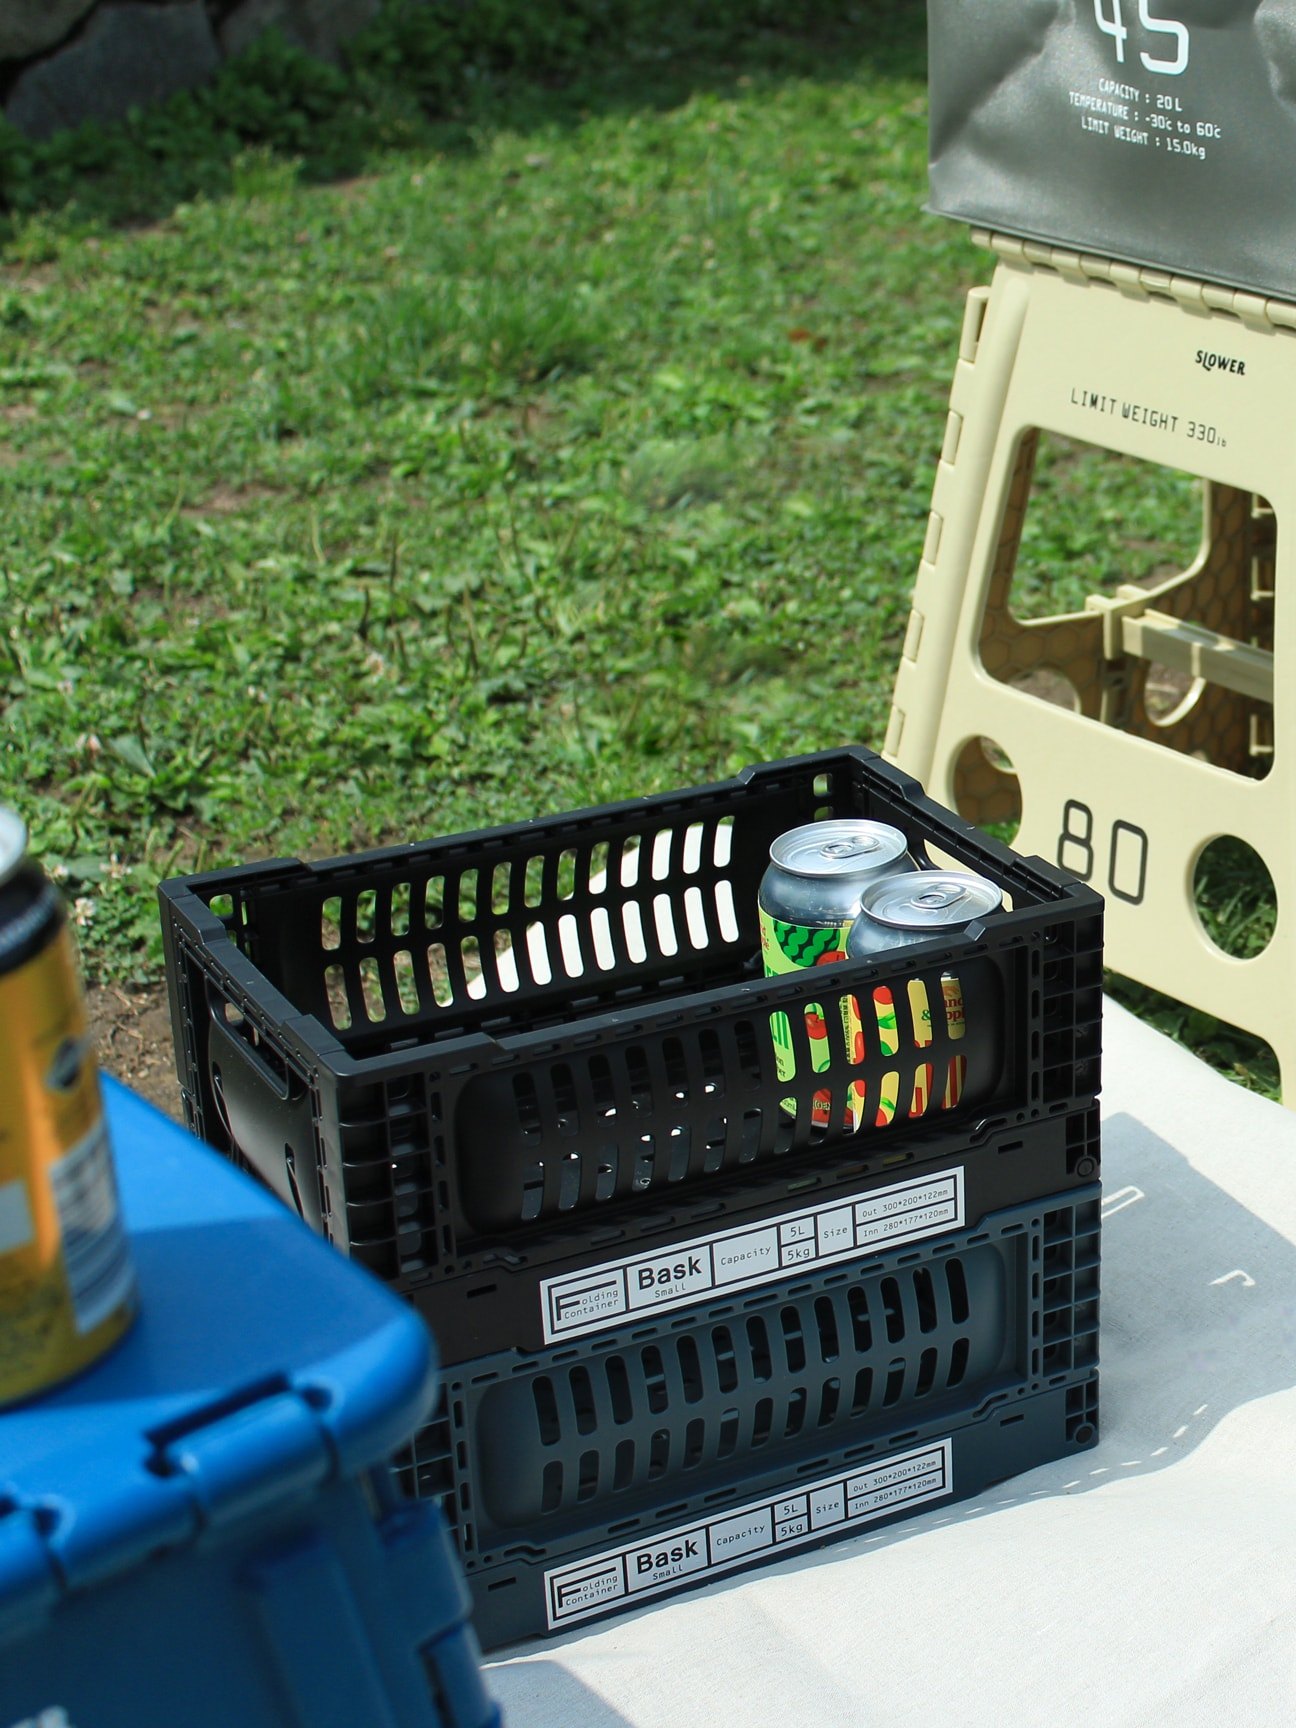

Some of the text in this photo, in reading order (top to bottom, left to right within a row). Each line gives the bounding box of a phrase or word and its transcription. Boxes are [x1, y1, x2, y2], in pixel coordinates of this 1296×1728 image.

[1094, 0, 1189, 75] 45
[1099, 78, 1140, 103] CAPACITY
[1069, 91, 1129, 120] TEMPERATURE
[1177, 120, 1191, 134] to
[1081, 116, 1110, 135] LIMIT
[1114, 125, 1149, 145] WEIGHT
[1166, 137, 1206, 160] 15.0kg
[1195, 350, 1246, 376] SLOWER
[1071, 387, 1117, 415] LIMIT
[1121, 403, 1179, 432] WEIGHT
[1057, 799, 1148, 906] 80
[862, 1208, 877, 1218] Out
[790, 1226, 805, 1238] 5L
[823, 1226, 848, 1239] Size
[863, 1227, 879, 1237] Inn
[720, 1244, 772, 1266] Capacity
[787, 1246, 811, 1262] 5kg
[637, 1255, 703, 1291] Bask
[555, 1279, 619, 1321] Folding
[654, 1282, 686, 1299] Small
[564, 1299, 619, 1320] Container
[853, 1482, 869, 1492] Out
[783, 1504, 799, 1516] 5L
[816, 1500, 840, 1514] Size
[854, 1499, 870, 1510] Inn
[716, 1524, 765, 1547] Capacity
[781, 1523, 803, 1537] 5kg
[636, 1538, 699, 1575] Bask
[652, 1564, 684, 1581] Small
[556, 1566, 618, 1608] Folding
[565, 1583, 619, 1607] Container
